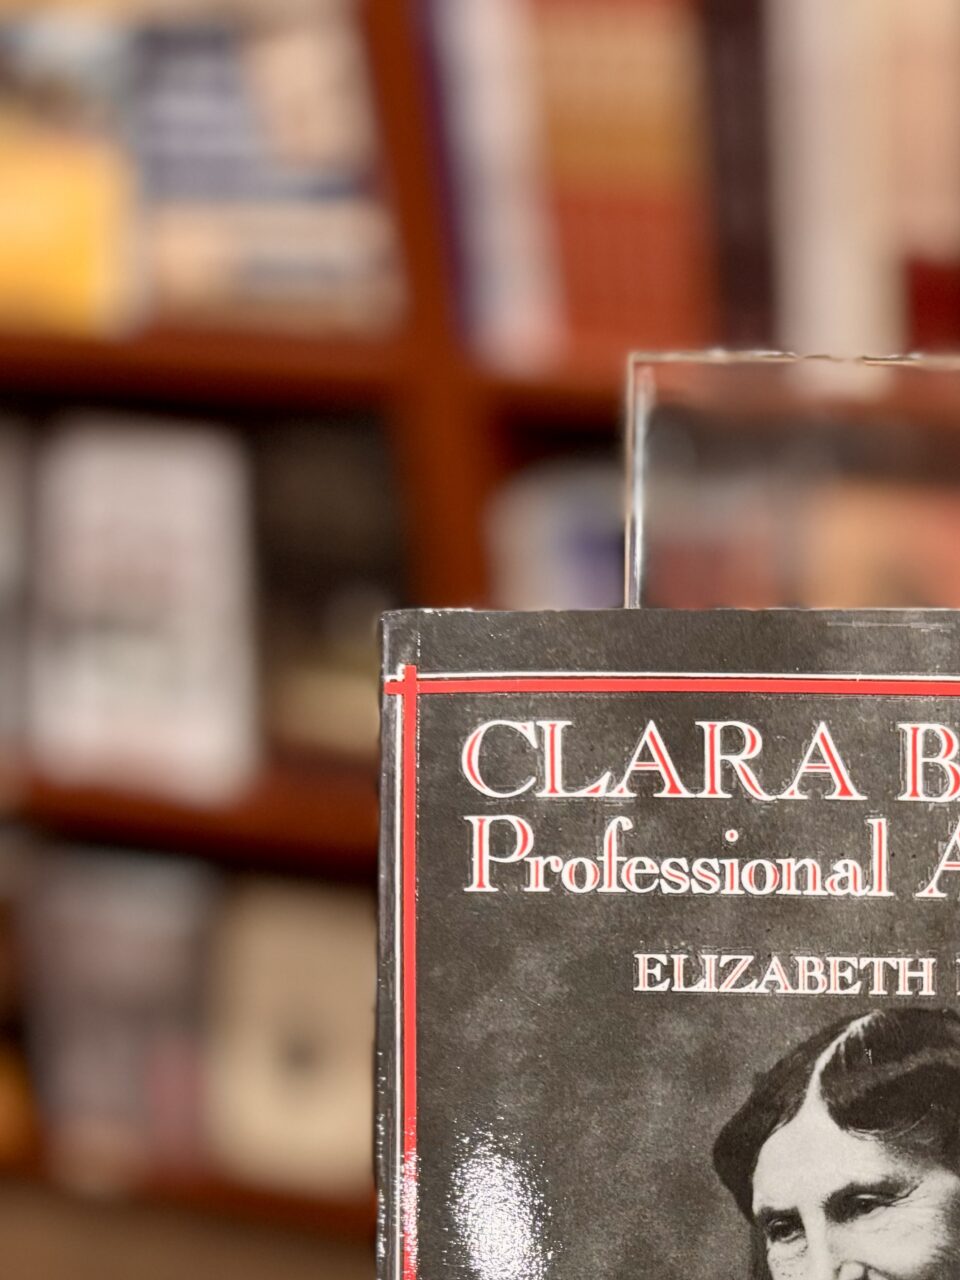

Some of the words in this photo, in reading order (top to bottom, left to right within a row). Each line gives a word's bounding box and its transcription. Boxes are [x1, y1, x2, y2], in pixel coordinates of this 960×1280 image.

[461, 720, 867, 801] CLARA
[463, 815, 892, 898] Professional
[633, 952, 936, 997] ELIZABETH
